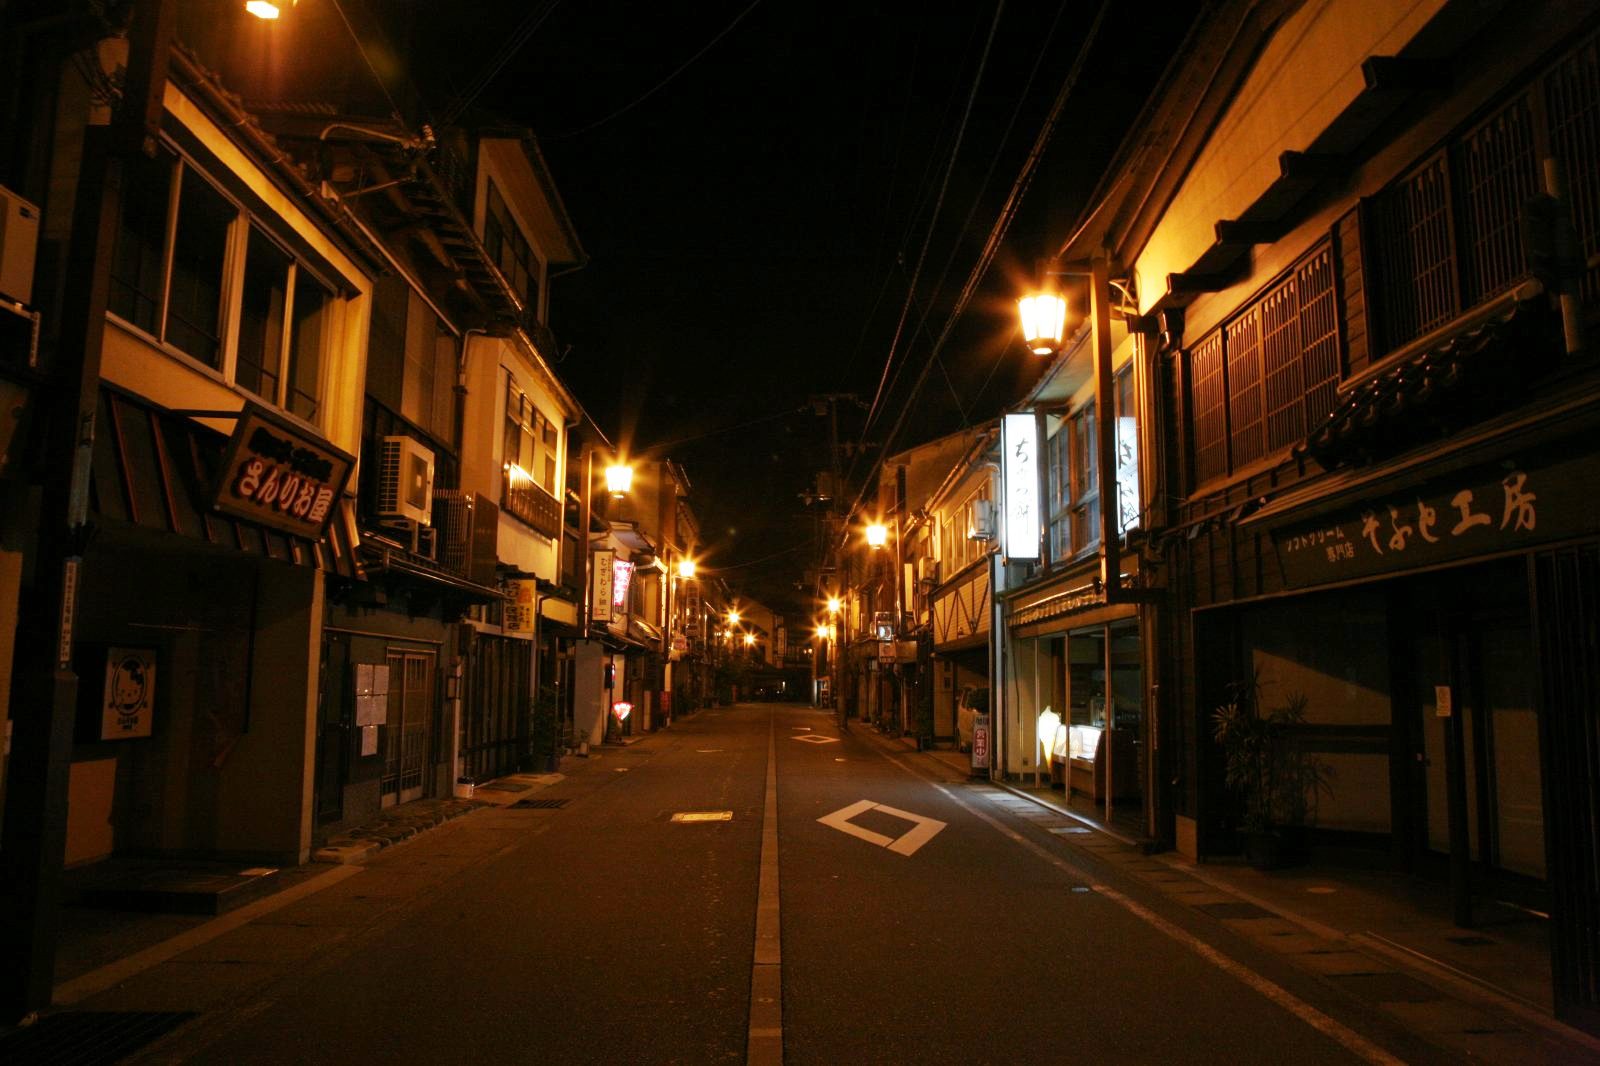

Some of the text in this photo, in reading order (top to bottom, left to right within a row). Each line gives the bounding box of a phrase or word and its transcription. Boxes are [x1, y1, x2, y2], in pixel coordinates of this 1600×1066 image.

[237, 458, 333, 523] さんりお屋
[1361, 471, 1537, 555] そふと工房
[1286, 525, 1345, 552] ソフトクリーム
[1326, 541, 1355, 562] 専門店
